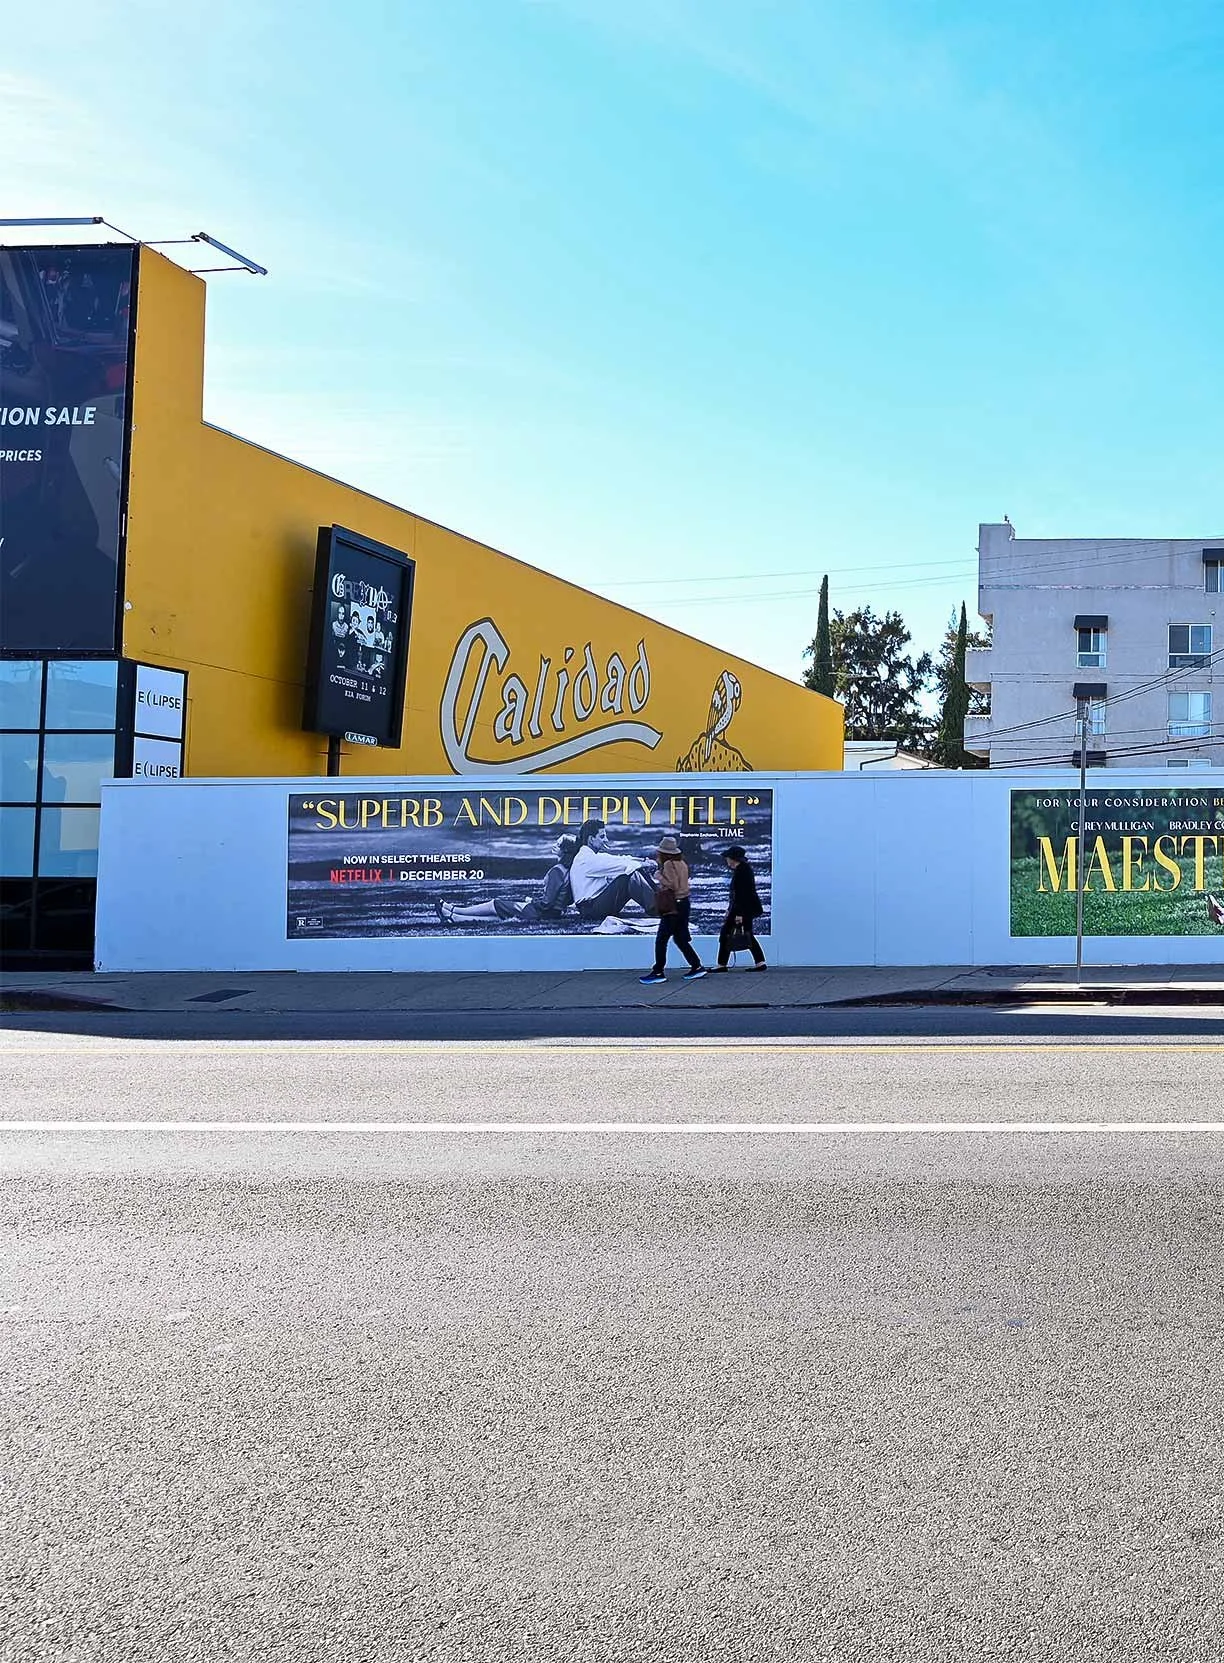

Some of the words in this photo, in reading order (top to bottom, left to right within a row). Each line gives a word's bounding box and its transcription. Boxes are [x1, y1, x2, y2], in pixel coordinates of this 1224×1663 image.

[0, 407, 40, 426] ION
[44, 407, 97, 425] SALE
[0, 450, 42, 462] PRICES
[330, 674, 358, 688] OCTOBER
[361, 682, 368, 691] 11
[379, 686, 387, 696] 12
[440, 617, 663, 774] Calidad
[347, 733, 376, 745] LAMAR
[1036, 798, 1060, 807] FOR
[1066, 798, 1098, 807] YOUR
[1104, 797, 1208, 807] CONSIDERATION
[302, 798, 444, 830] “SUPERB
[453, 797, 529, 827] AND
[538, 796, 660, 826] DEEPLY
[1070, 821, 1103, 831] CREY
[1104, 821, 1154, 831] MULLIGAN
[1169, 820, 1212, 830] BRADLEY
[718, 828, 744, 838] TIME
[343, 856, 367, 864] NOW
[370, 856, 379, 864] IN
[381, 855, 418, 864] SELECT
[420, 854, 471, 862] THEATERS
[330, 869, 382, 883] NETFLIX
[400, 871, 467, 880] DECEMBER
[469, 870, 484, 879] 20
